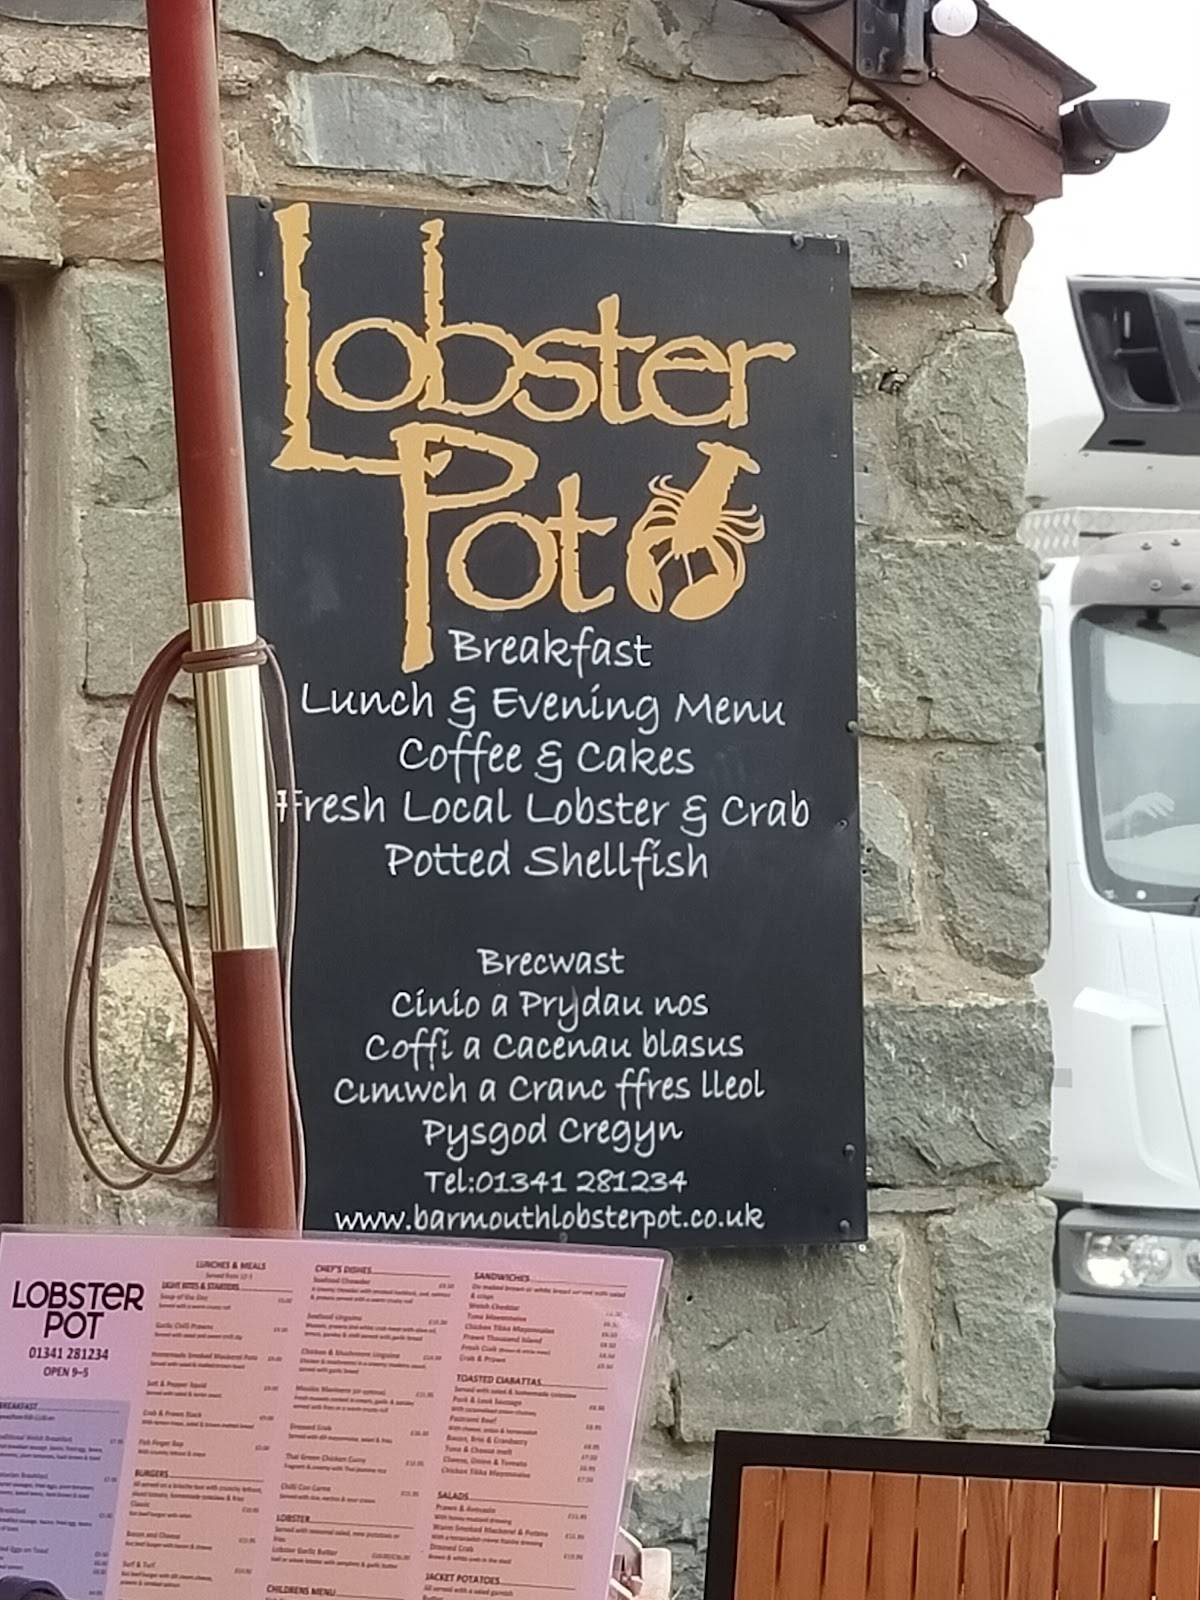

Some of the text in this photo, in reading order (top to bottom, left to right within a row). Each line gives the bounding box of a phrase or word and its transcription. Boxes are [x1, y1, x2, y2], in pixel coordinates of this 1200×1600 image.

[271, 202, 797, 475] Lobster
[389, 421, 618, 674] Pot
[448, 626, 652, 679] Breakfast
[301, 682, 787, 734] Lunch & Evening Menu
[400, 731, 696, 784] Coffee & Cakes
[276, 787, 810, 837] Fresh Local Lobster & Crab
[385, 837, 709, 890] Potted Shellfish
[477, 948, 625, 976] Brecwast
[391, 986, 709, 1032] Cinio a Prydau nos
[365, 1028, 744, 1071] Coffi a Cacenau blasus
[334, 1067, 766, 1110] Cimwch a Cranc ffres lleol
[423, 1115, 683, 1161] Pysgod Cregyn
[424, 1170, 687, 1194] Tel:01341 281234
[335, 1203, 766, 1239] www.barmouthlobsterpot.co.uk
[315, 1265, 372, 1274] CHEF'S DISHES
[474, 1272, 530, 1282] SANDWICHES
[44, 1311, 104, 1340] POT
[29, 1346, 108, 1360] 01341 281234
[43, 1367, 69, 1376] OPEN
[457, 1374, 542, 1386] TOASTED CIABATTAS
[135, 1469, 168, 1478] BURGERS
[438, 1491, 469, 1499] SALADS
[276, 1514, 310, 1523] LOBSTER
[267, 1585, 336, 1596] CHILDRENS MENU
[425, 1573, 500, 1584] JACKET POTATOES
